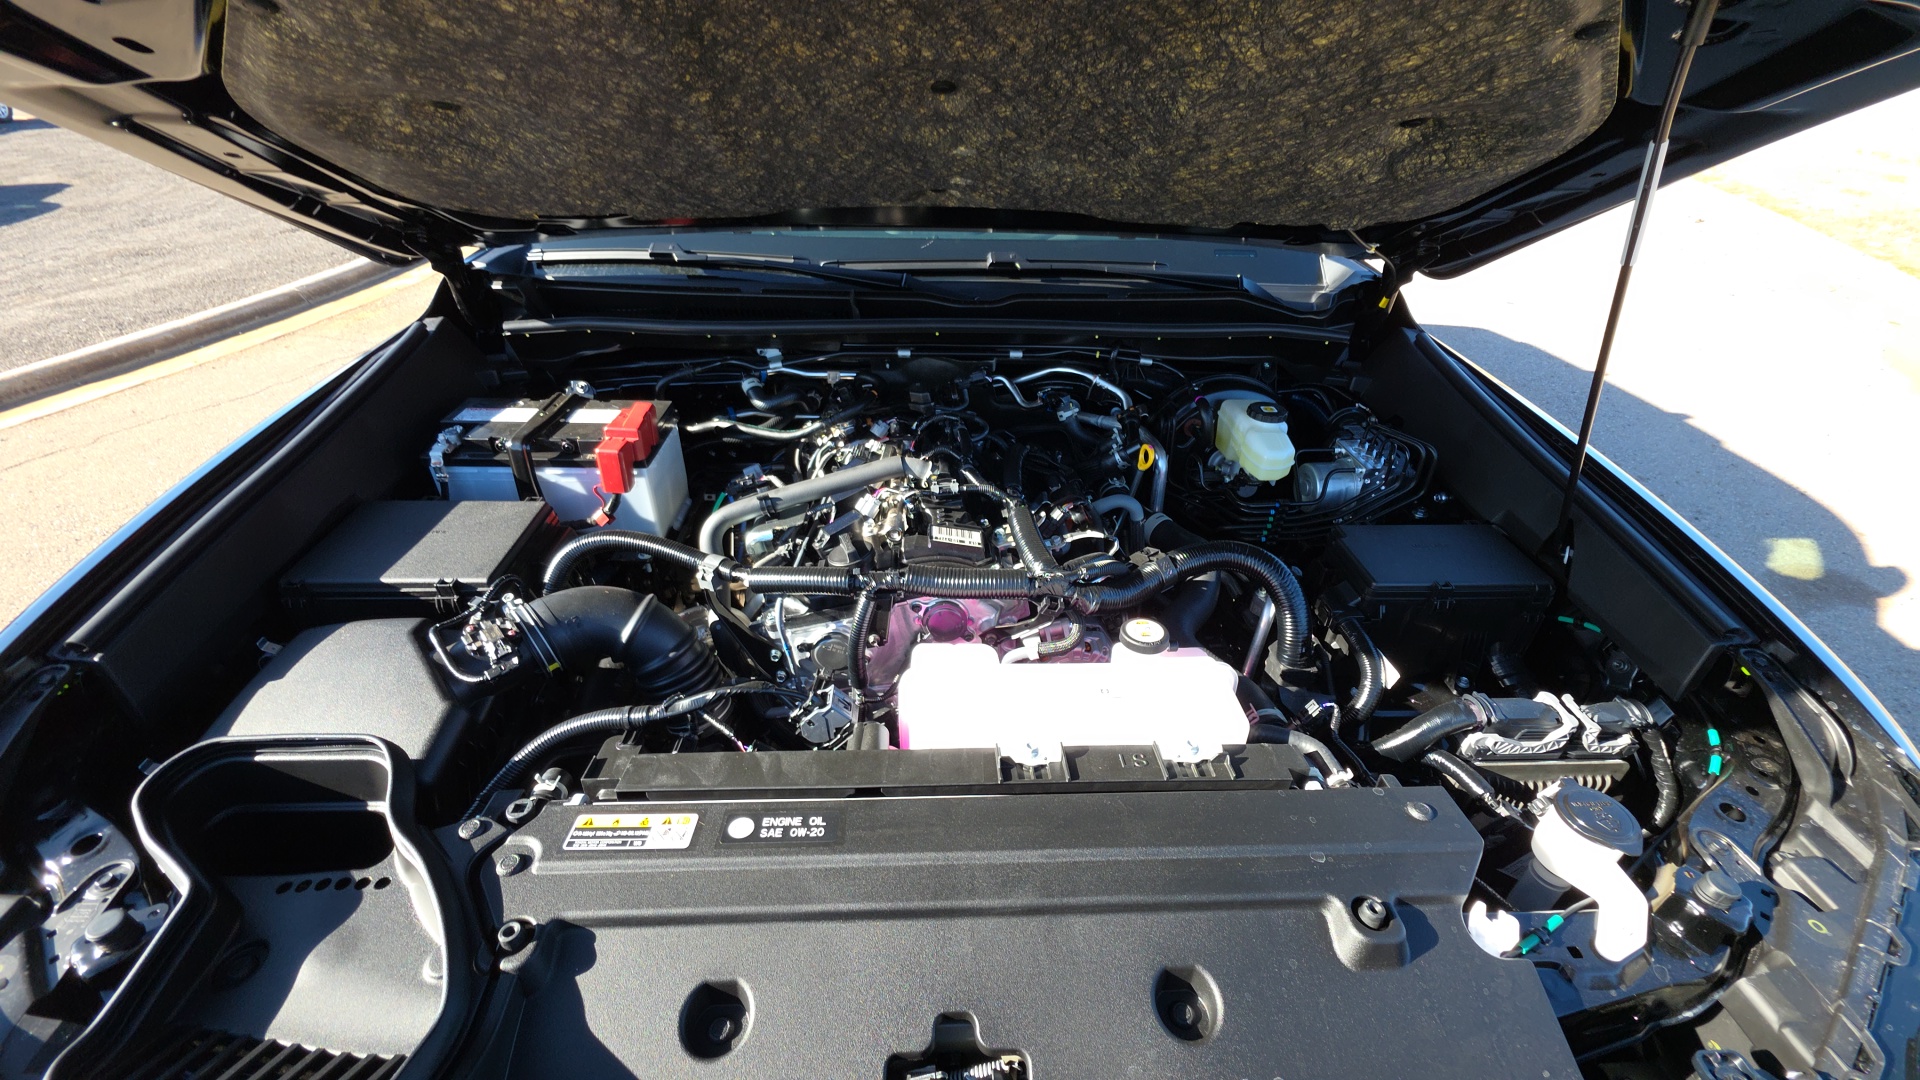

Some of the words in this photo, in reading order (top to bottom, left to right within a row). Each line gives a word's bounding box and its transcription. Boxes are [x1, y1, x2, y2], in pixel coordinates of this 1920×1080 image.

[761, 816, 803, 827] ENGINE
[808, 816, 827, 826] OIL
[759, 827, 784, 838] SAE
[789, 827, 825, 837] 0W-20
